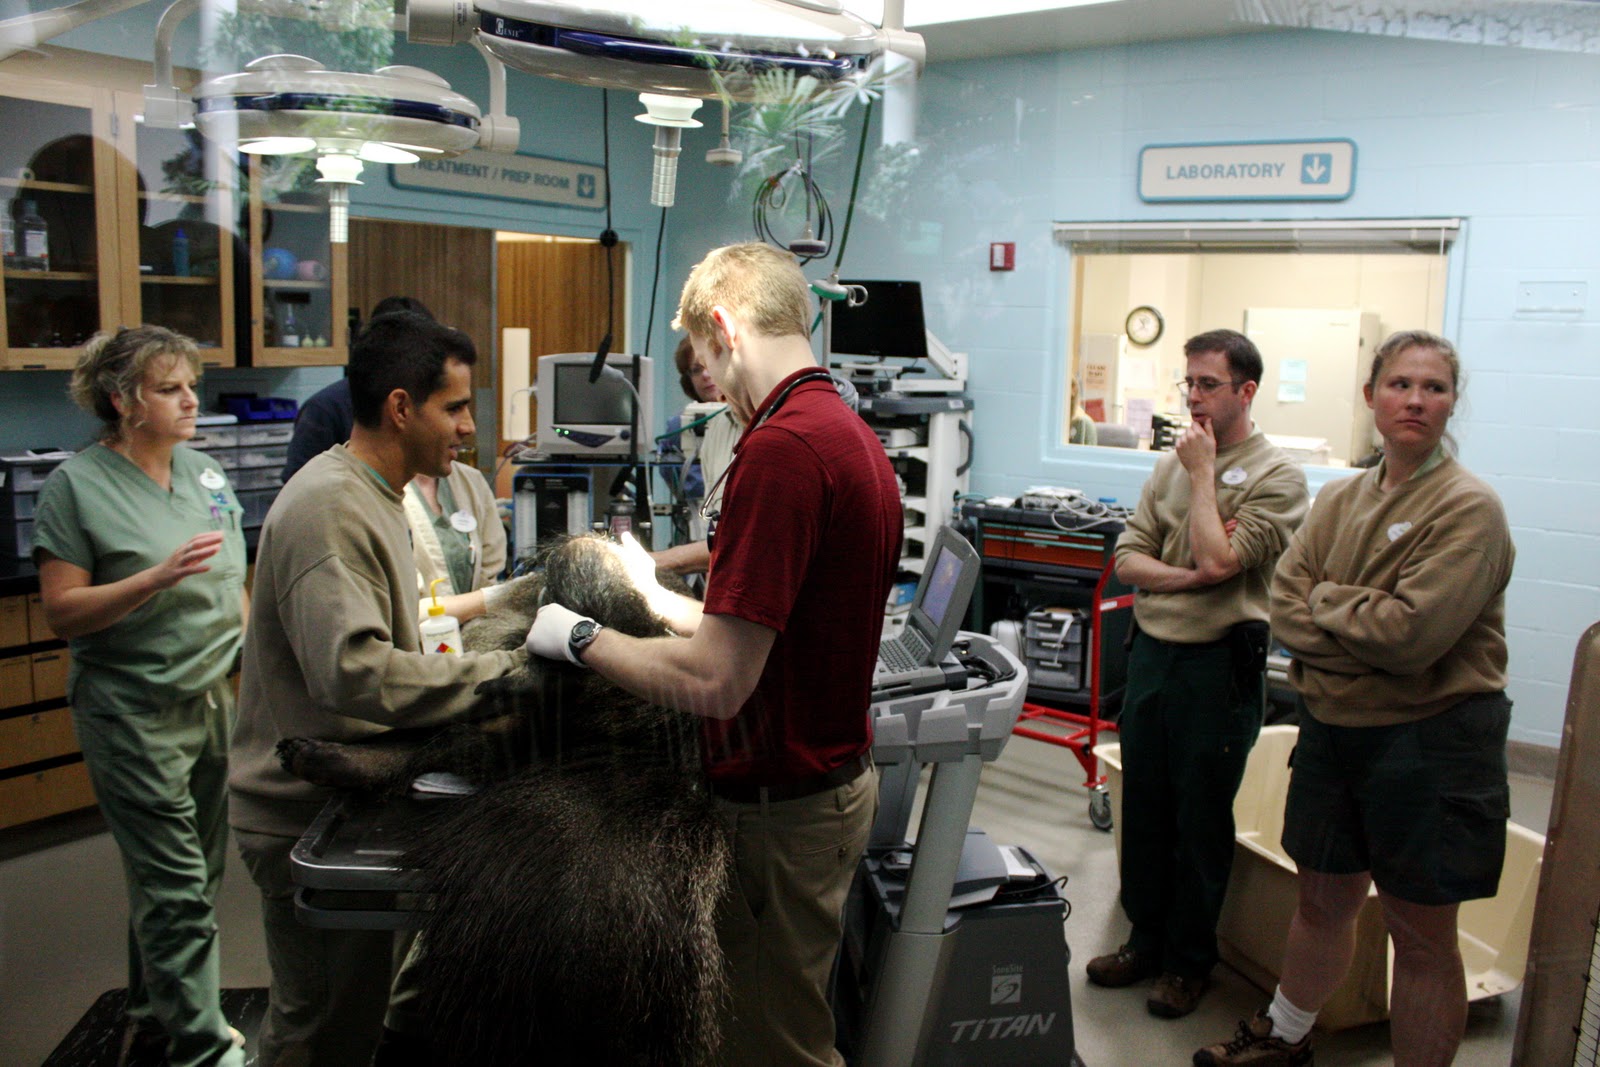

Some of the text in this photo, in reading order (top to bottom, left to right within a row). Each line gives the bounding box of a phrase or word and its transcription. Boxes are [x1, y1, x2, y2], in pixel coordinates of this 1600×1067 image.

[501, 168, 531, 183] PREP
[533, 173, 570, 189] ROOM
[1166, 163, 1286, 180] LABORATORY
[950, 1012, 1056, 1043] TITAN
